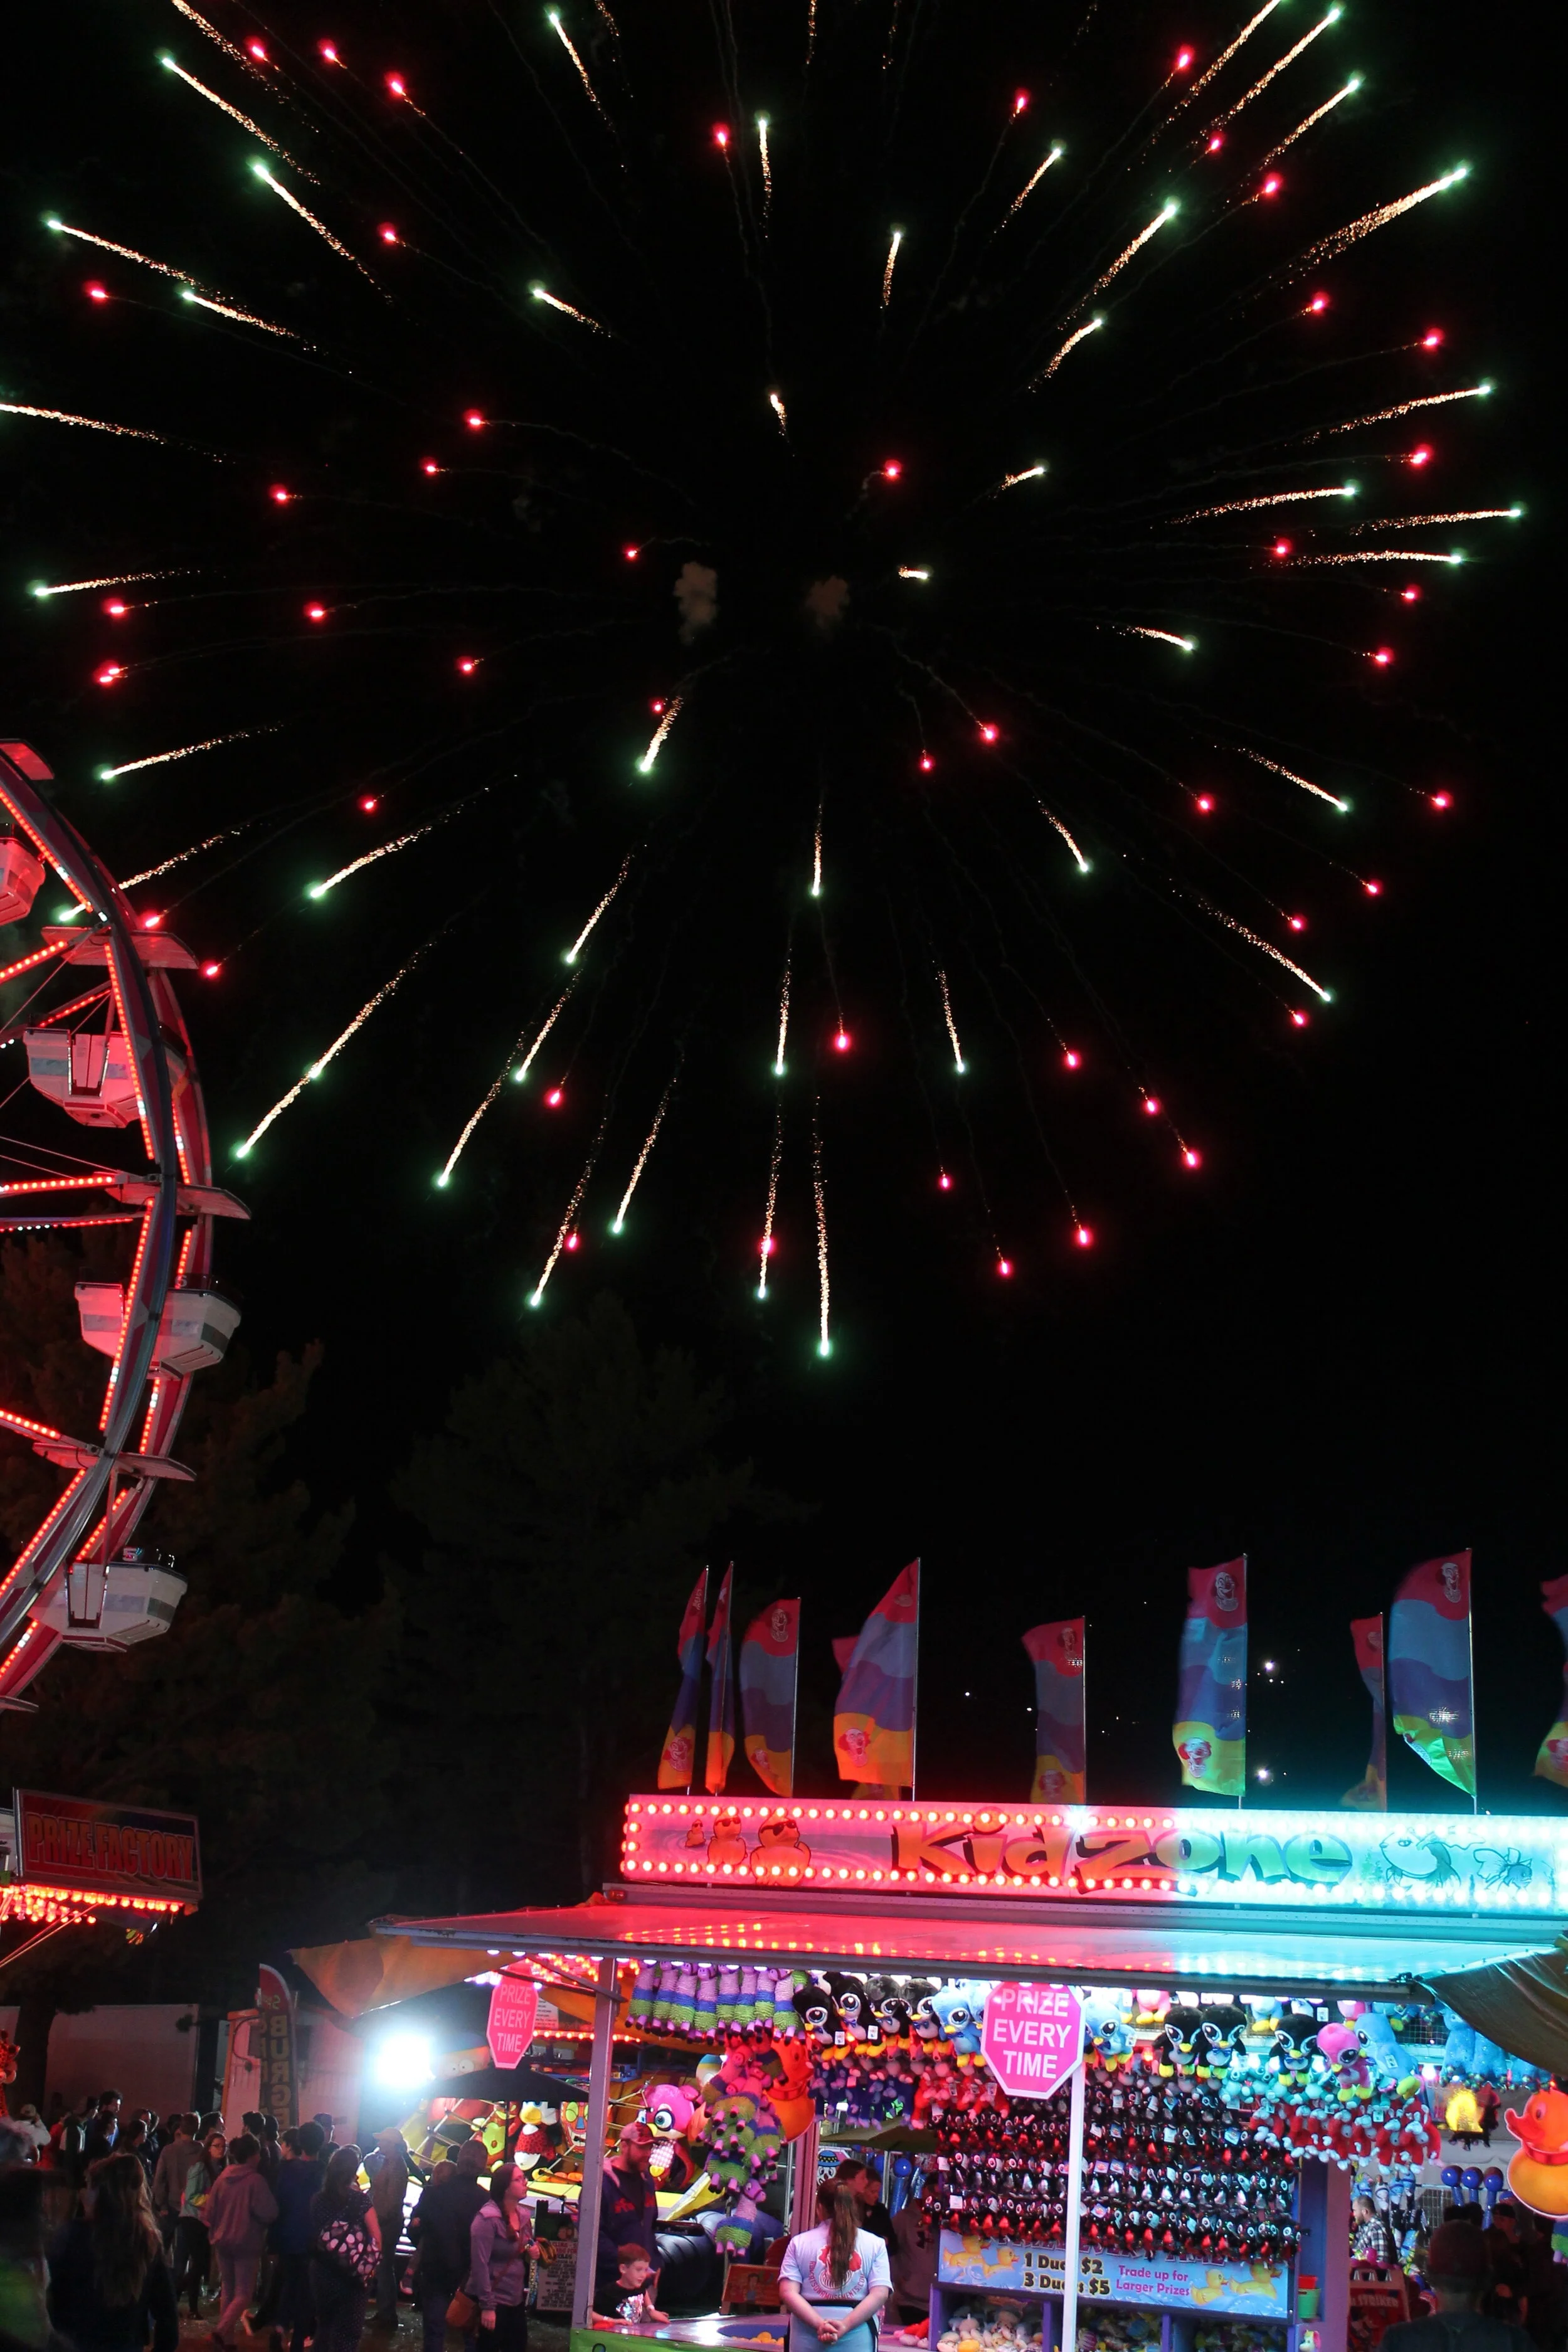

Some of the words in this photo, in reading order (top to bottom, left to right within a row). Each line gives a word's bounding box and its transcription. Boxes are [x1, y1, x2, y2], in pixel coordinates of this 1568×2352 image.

[27, 1812, 95, 1869] PRIZE
[95, 1822, 194, 1882] FACTORY
[499, 1984, 532, 2005] PRIZE
[1001, 1988, 1069, 2017] PRIZE
[494, 2008, 531, 2028] EVERY
[497, 2032, 522, 2052] TIME
[993, 2018, 1072, 2048] EVERY
[1003, 2050, 1057, 2079] TIME
[1024, 2252, 1032, 2267] 1
[1038, 2254, 1065, 2271] Duc
[1081, 2257, 1103, 2275] $2
[1118, 2265, 1152, 2278] Trade
[1155, 2270, 1170, 2282] up
[1172, 2269, 1189, 2282] for
[1024, 2272, 1034, 2287] 3
[1039, 2274, 1084, 2293] Dus
[1089, 2277, 1110, 2296] $5
[1116, 2279, 1153, 2293] Larger
[1157, 2283, 1190, 2296] Prizes
